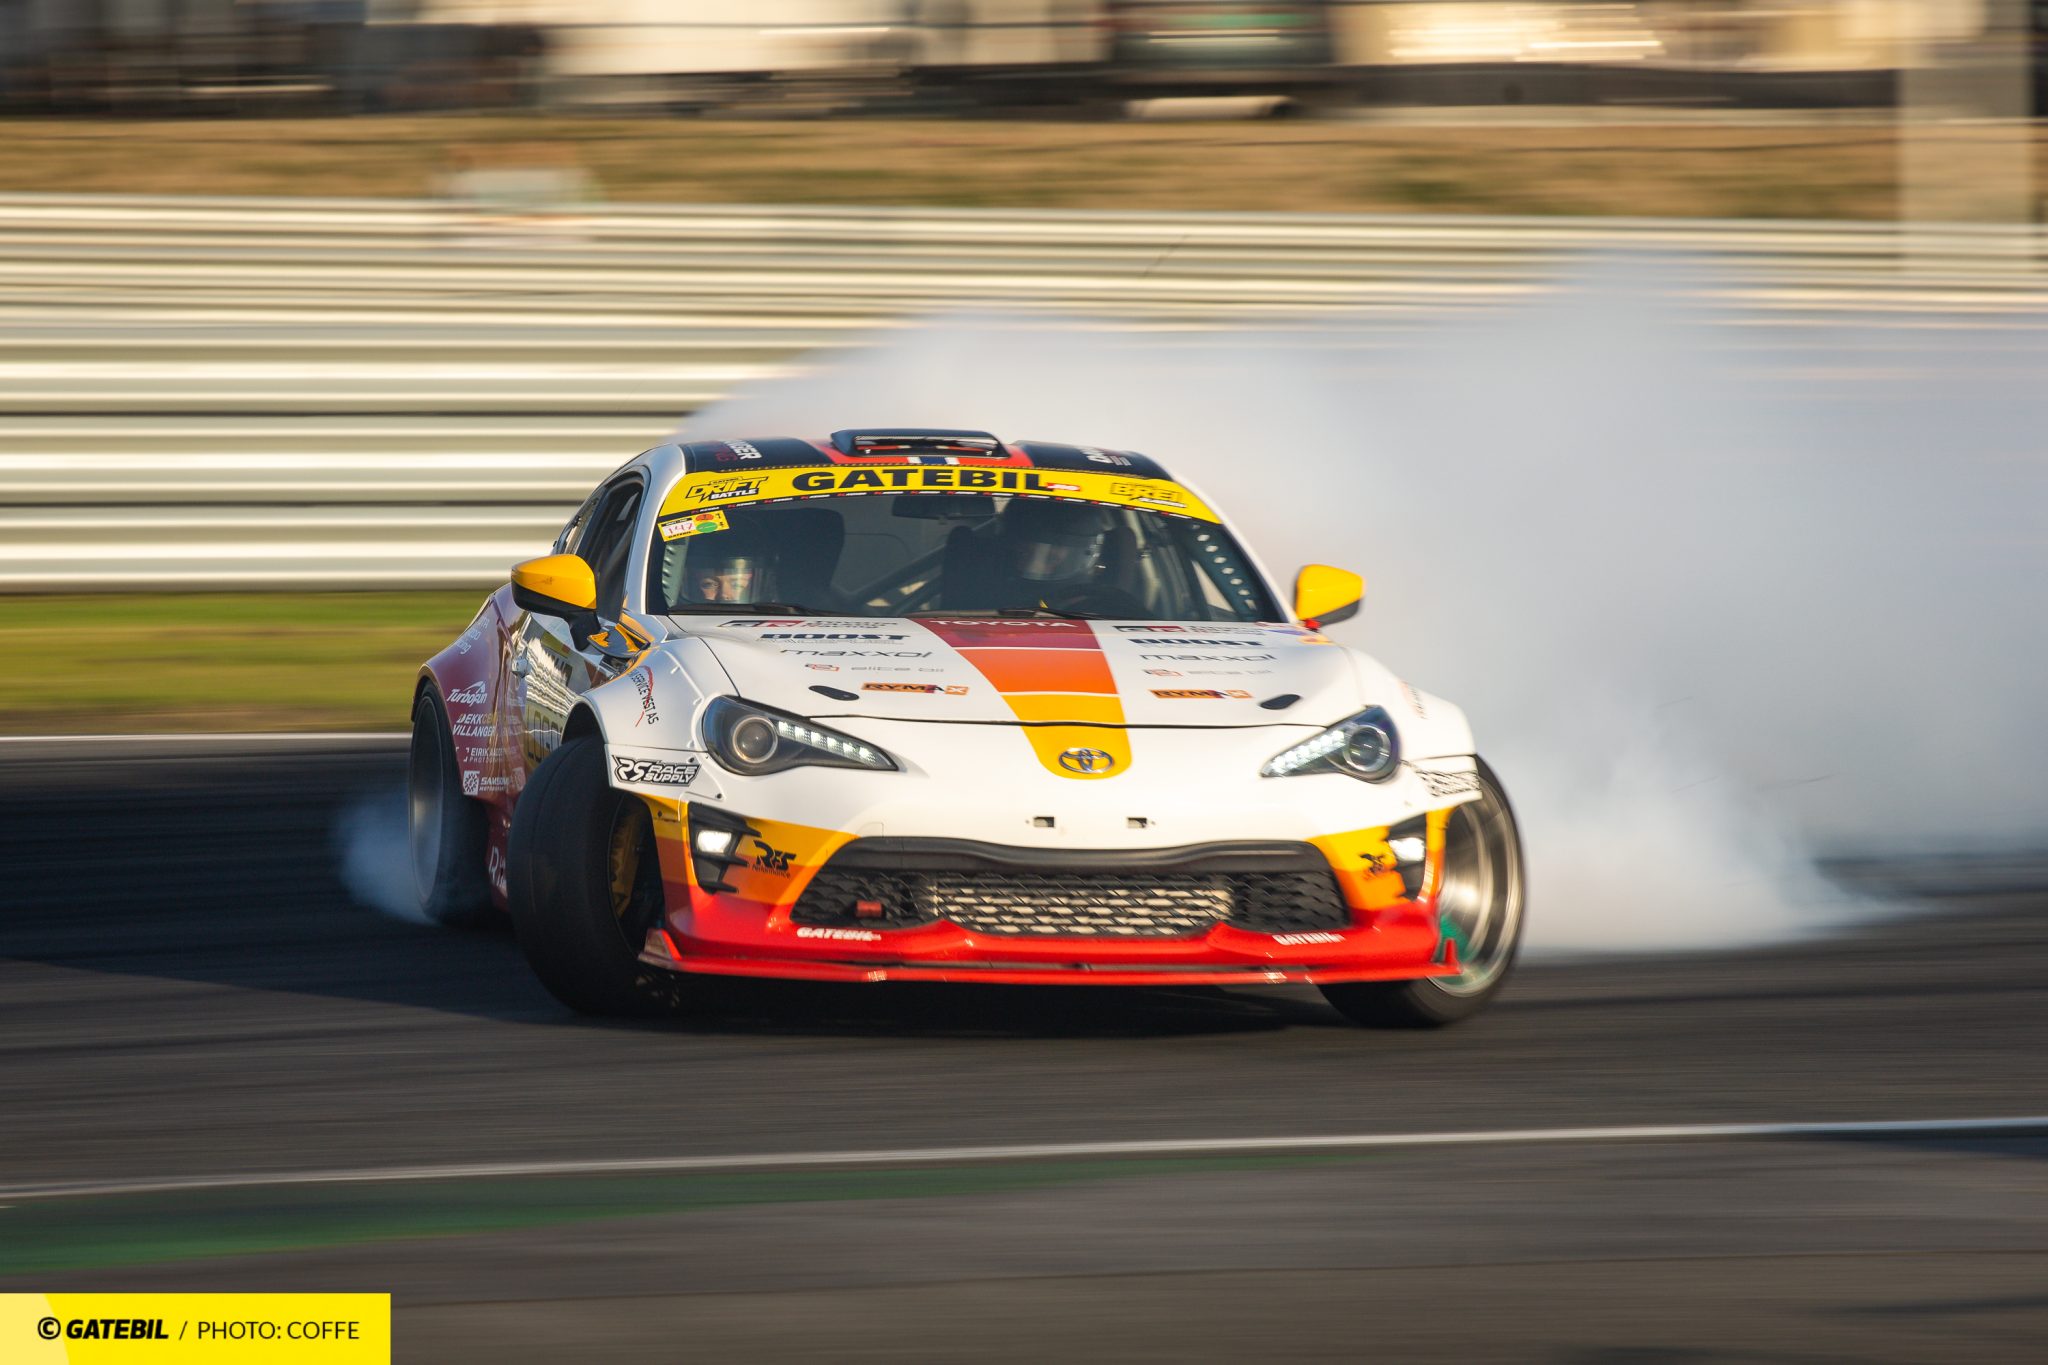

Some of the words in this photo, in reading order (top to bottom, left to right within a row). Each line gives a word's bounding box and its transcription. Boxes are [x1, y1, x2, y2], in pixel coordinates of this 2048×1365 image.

[791, 468, 1053, 492] GATEBIL
[686, 477, 769, 502] DRIFT
[710, 489, 757, 500] BATTLE
[928, 620, 1079, 628] TOYOTA
[760, 633, 911, 641] BOOST
[780, 649, 933, 658] maxxol
[864, 683, 968, 695] RYMAX
[646, 711, 660, 725] AS
[648, 764, 698, 775] RACE
[643, 773, 693, 783] SUPPLY
